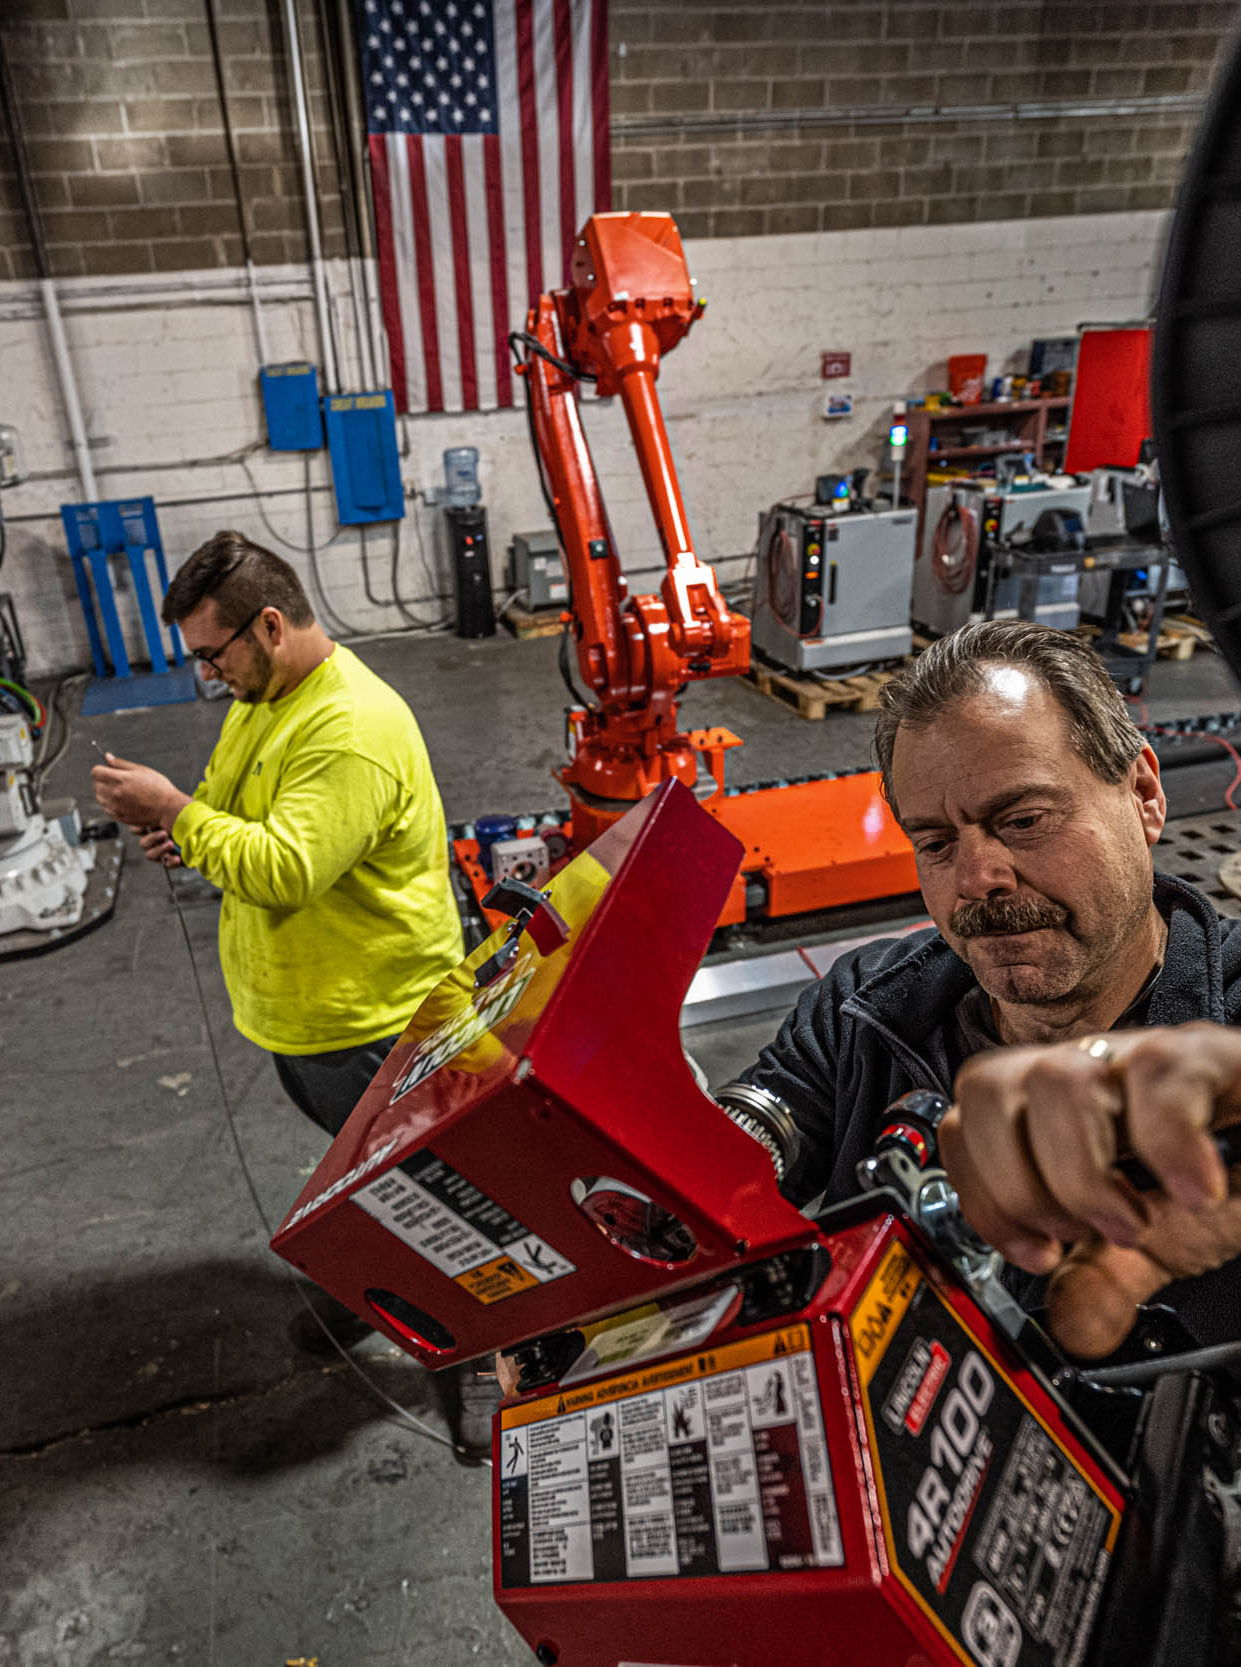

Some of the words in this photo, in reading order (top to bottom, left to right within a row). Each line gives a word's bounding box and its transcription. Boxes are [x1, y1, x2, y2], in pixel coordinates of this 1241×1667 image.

[885, 1343, 931, 1427] LINCOLN
[907, 1350, 995, 1560] 4R100
[926, 1429, 993, 1588] AUTODRIVE
